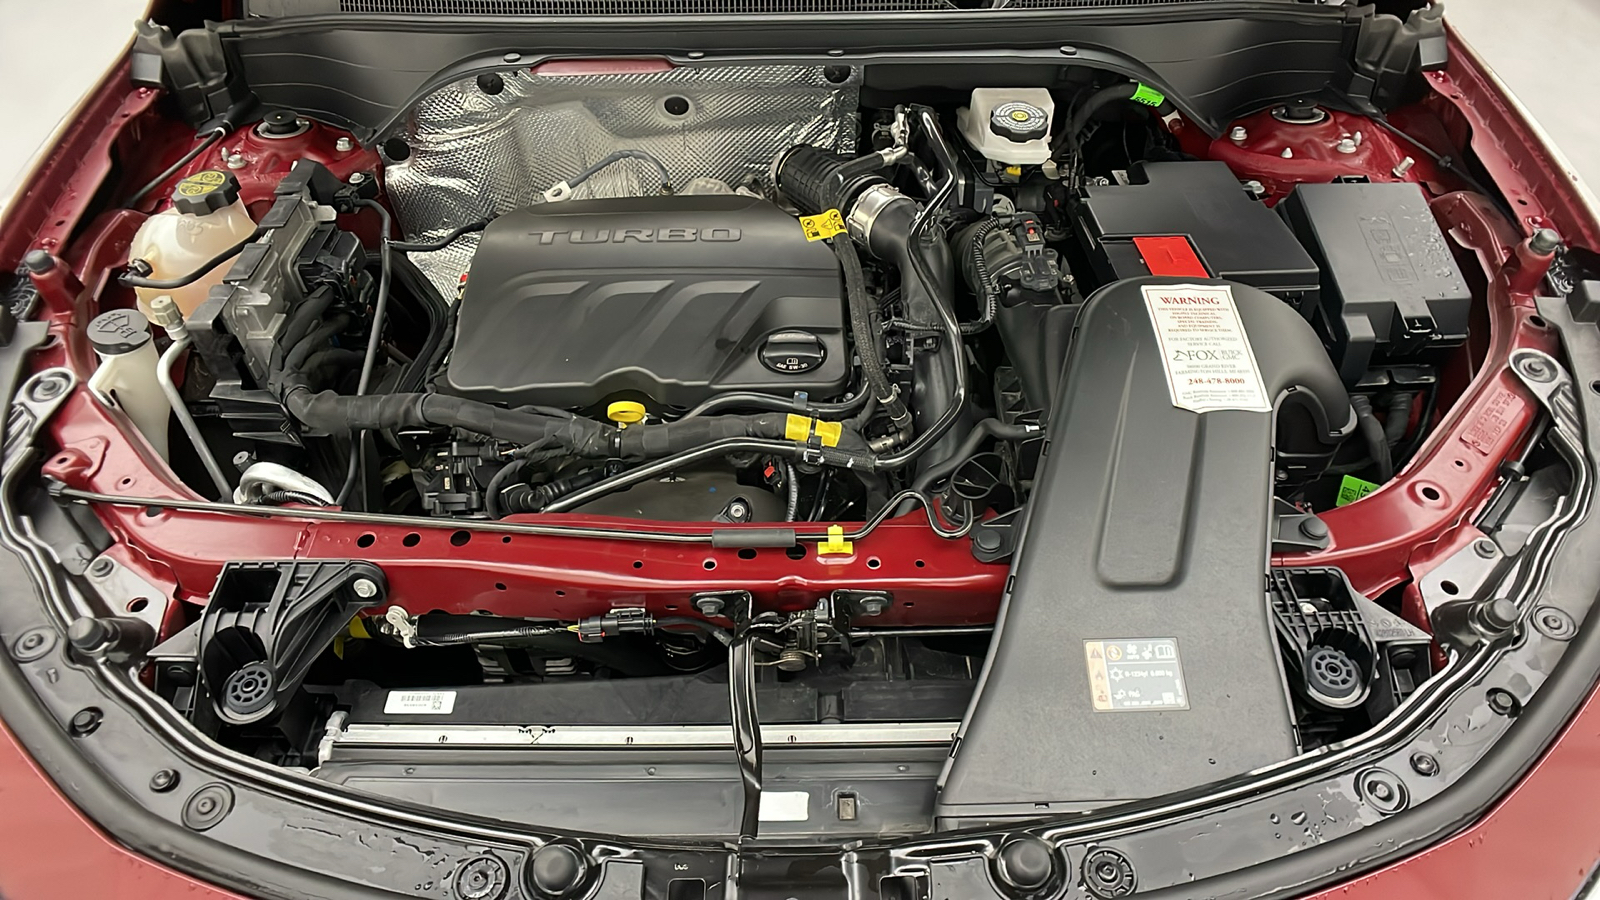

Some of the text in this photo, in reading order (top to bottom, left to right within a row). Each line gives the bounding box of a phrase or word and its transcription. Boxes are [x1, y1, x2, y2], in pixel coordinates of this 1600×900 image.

[528, 228, 742, 246] TURBO
[1160, 296, 1220, 305] WARNING
[1187, 350, 1219, 360] FOX
